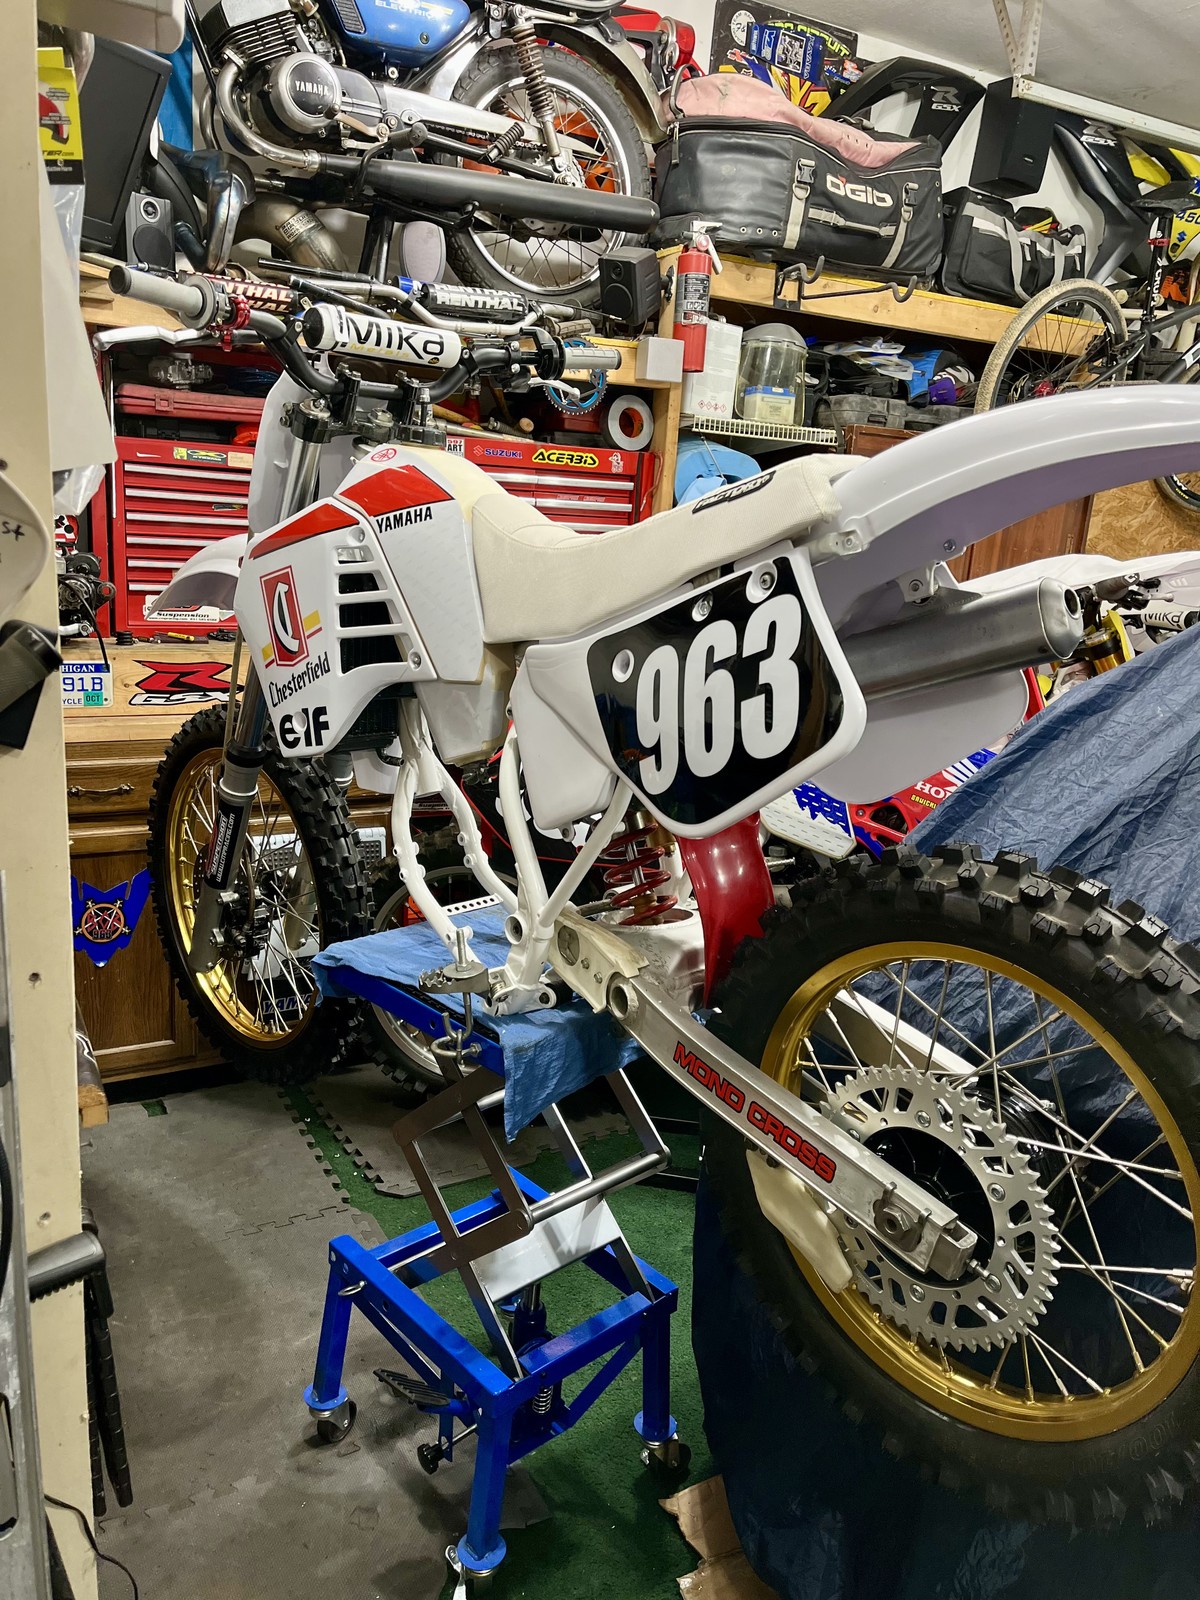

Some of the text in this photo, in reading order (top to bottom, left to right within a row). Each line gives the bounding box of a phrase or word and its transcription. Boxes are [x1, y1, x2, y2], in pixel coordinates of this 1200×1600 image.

[295, 80, 329, 96] YAMAHA
[931, 103, 962, 112] GSX
[1080, 135, 1117, 147] GSX
[826, 173, 893, 207] OGIO
[436, 291, 524, 312] RENTHAL
[447, 444, 462, 452] ART
[484, 448, 522, 459] SUZUKI
[376, 506, 433, 534] YAMAHA
[62, 664, 95, 673] HIGAN
[268, 651, 331, 708] Chesterfield
[85, 695, 100, 703] OCT
[636, 593, 802, 795] 963
[279, 706, 330, 749] elf
[673, 1040, 836, 1183] MONO CROSS
